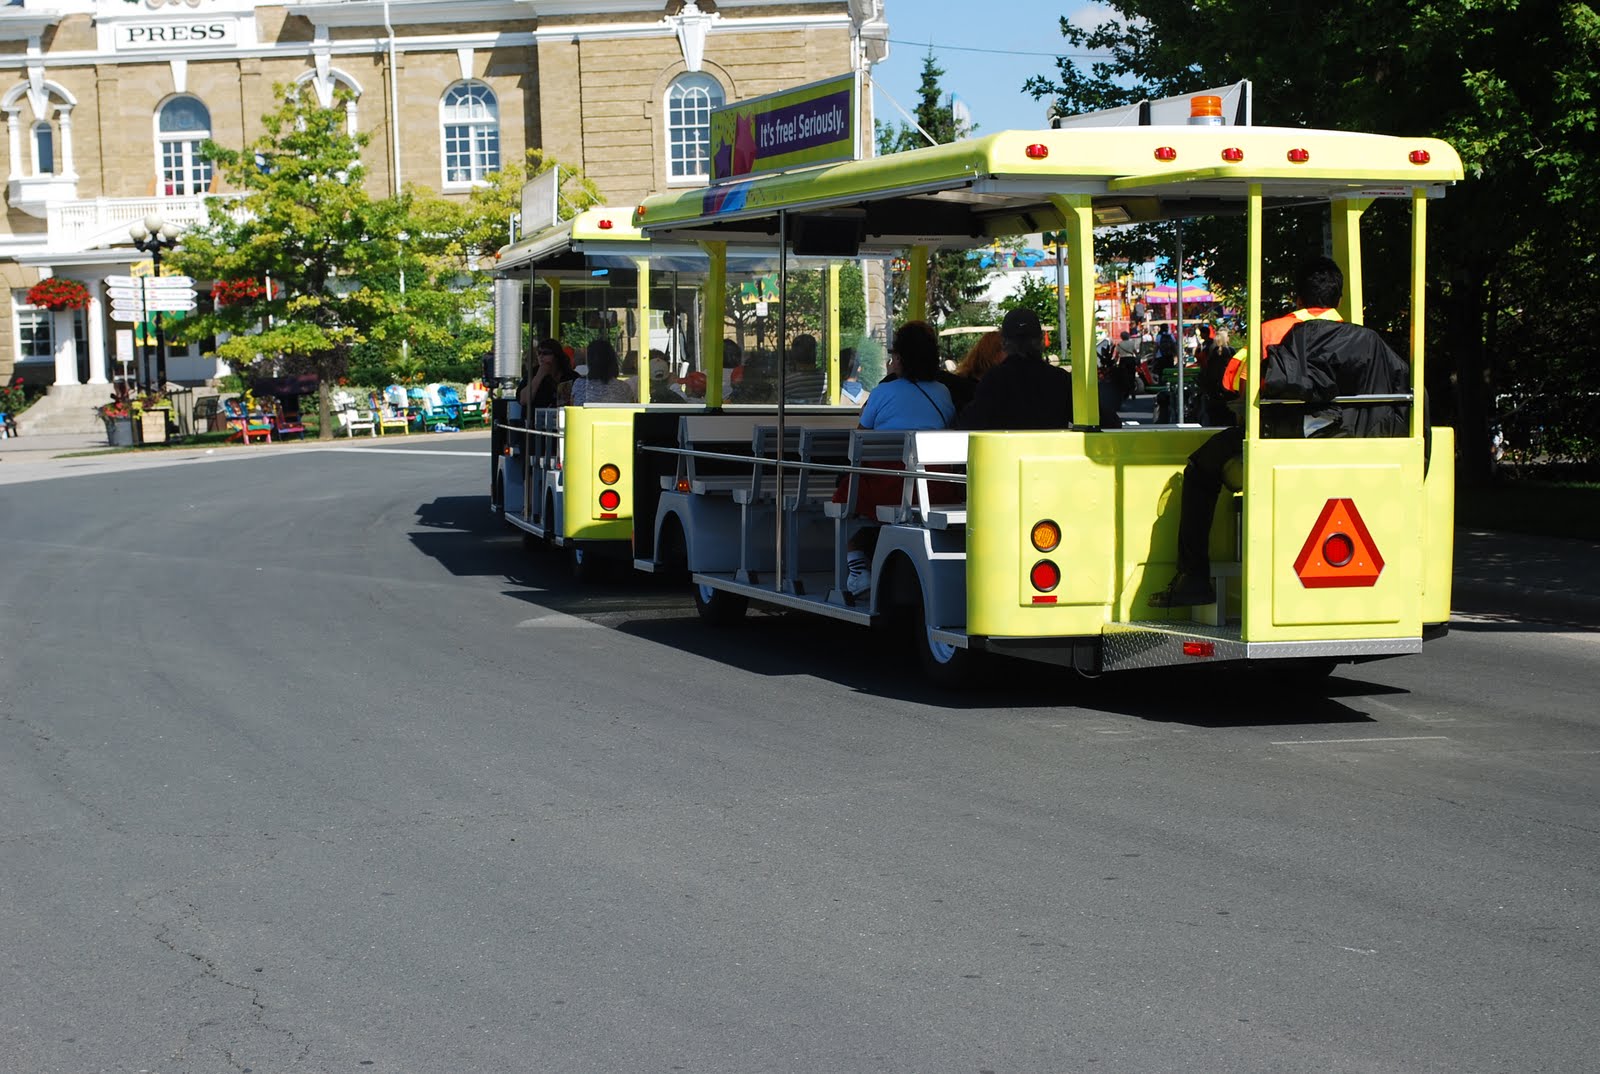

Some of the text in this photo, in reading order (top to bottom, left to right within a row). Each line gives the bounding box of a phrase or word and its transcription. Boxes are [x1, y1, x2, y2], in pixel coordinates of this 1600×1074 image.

[127, 24, 226, 42] PRESS
[760, 104, 844, 148] It's free! Seriously.
